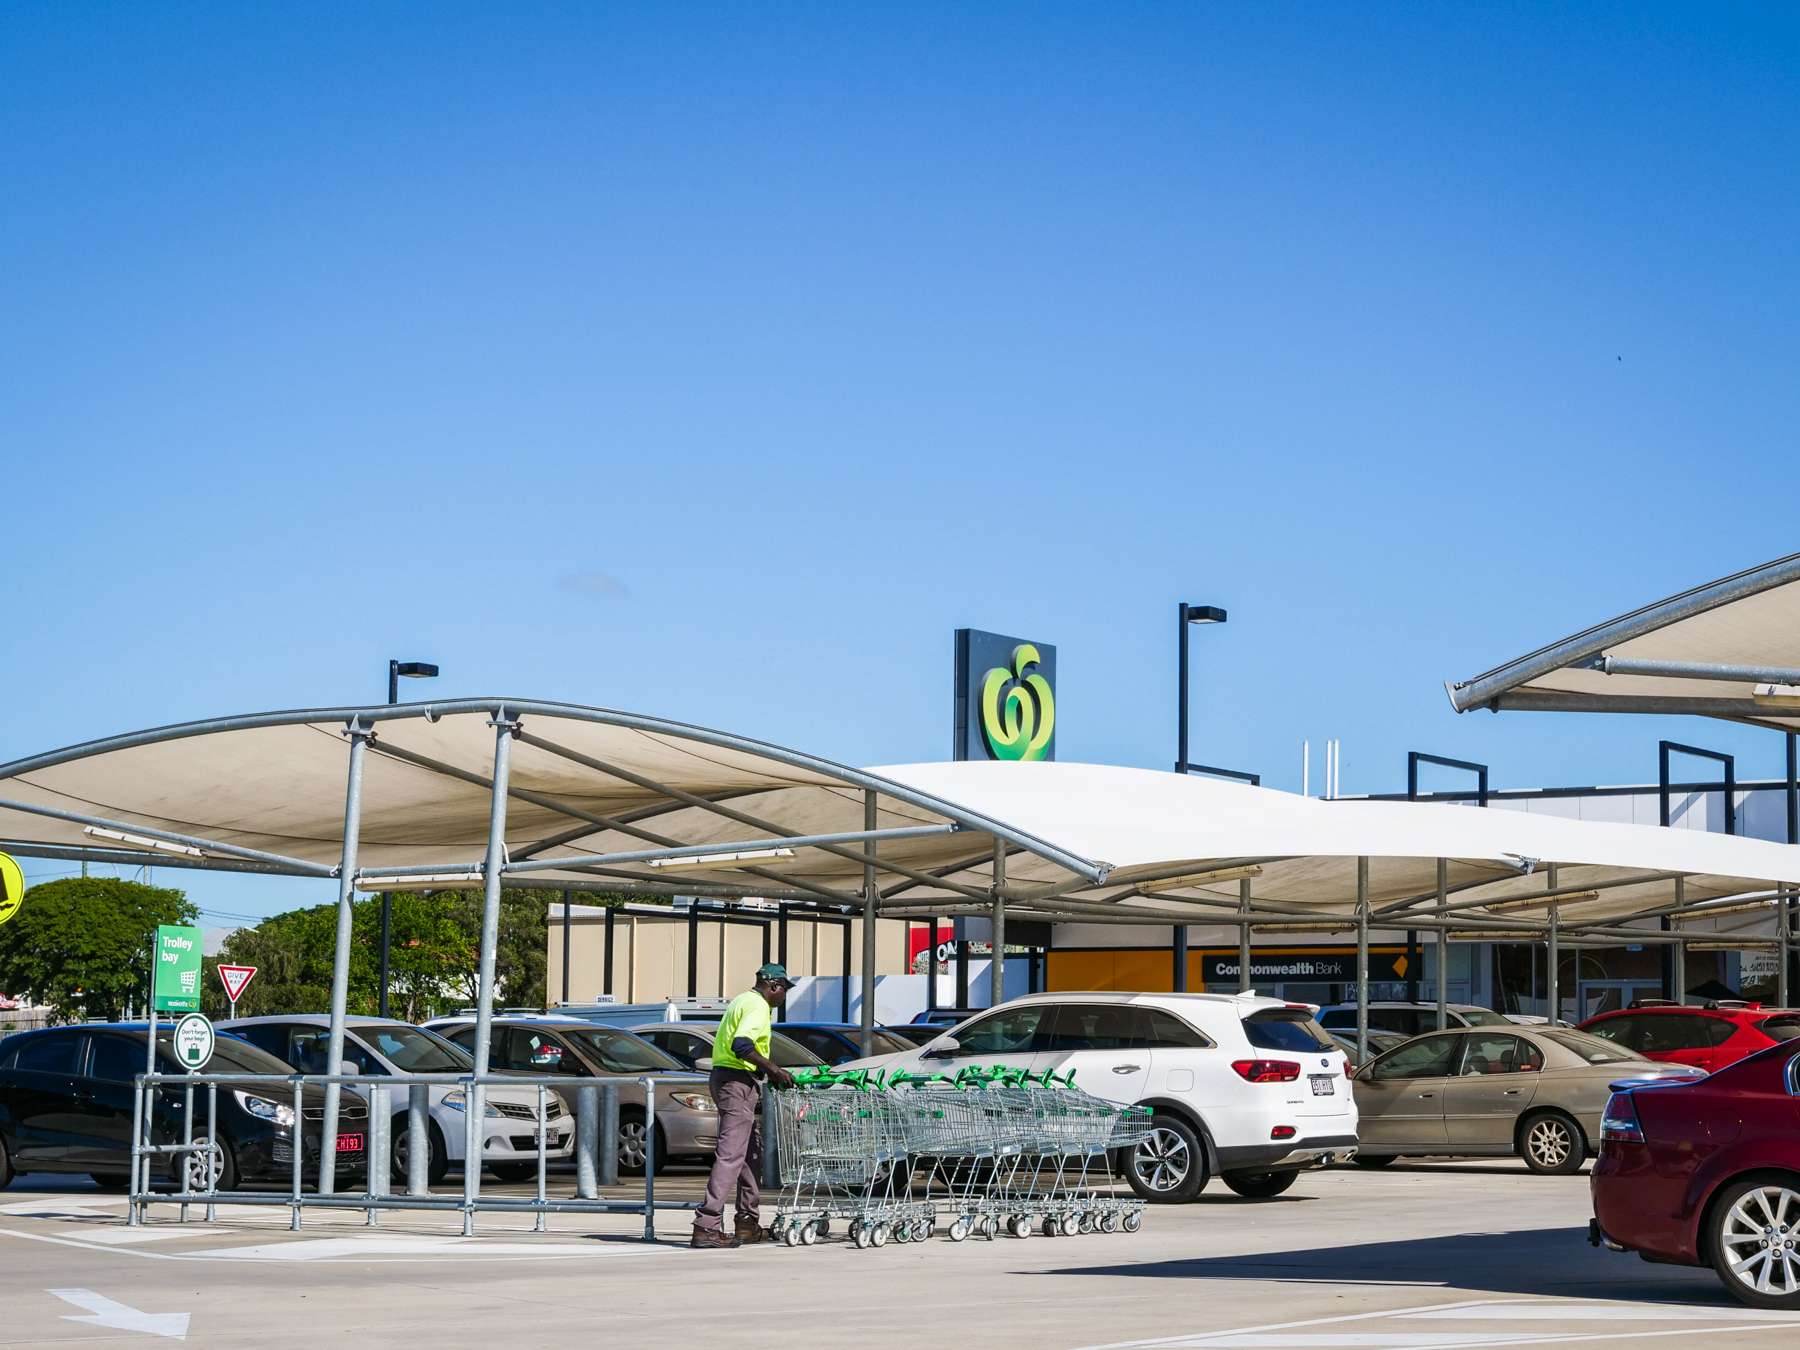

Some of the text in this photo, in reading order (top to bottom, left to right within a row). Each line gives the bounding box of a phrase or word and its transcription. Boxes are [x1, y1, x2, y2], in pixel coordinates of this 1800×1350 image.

[163, 936, 193, 950] Trolley
[162, 951, 179, 964] bay
[1316, 962, 1343, 975] Bank
[227, 972, 245, 980] GIVE
